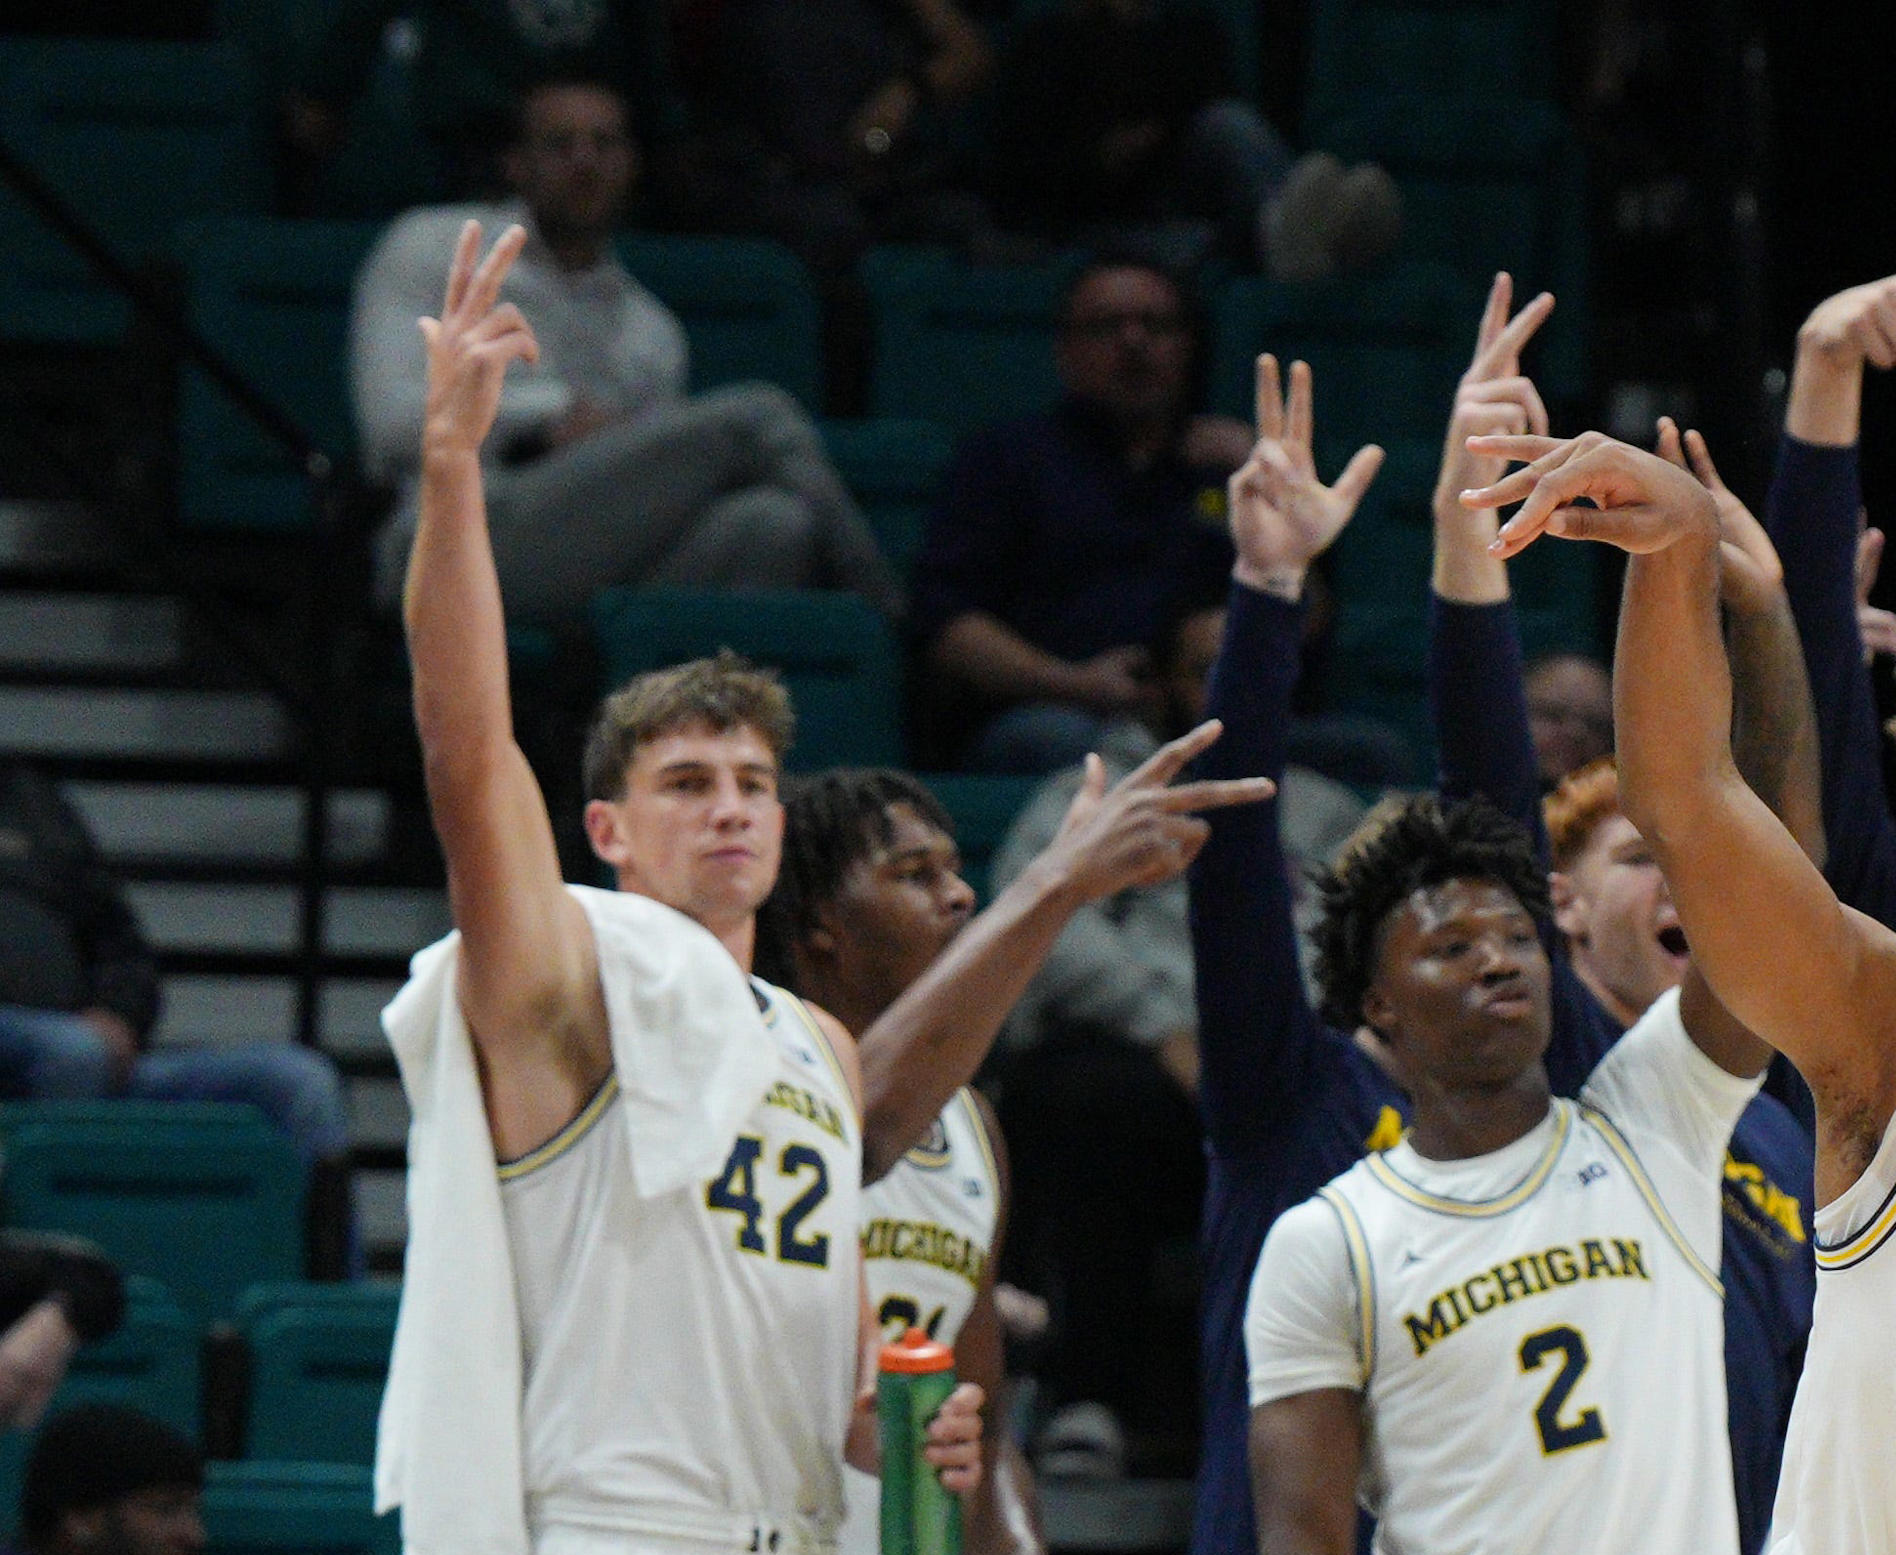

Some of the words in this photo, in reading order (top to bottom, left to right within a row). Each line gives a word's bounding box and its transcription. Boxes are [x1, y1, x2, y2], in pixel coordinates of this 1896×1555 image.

[708, 1136, 829, 1268] 42
[1404, 1239, 1648, 1357] MICHIGAN
[1520, 1325, 1607, 1455] 2
